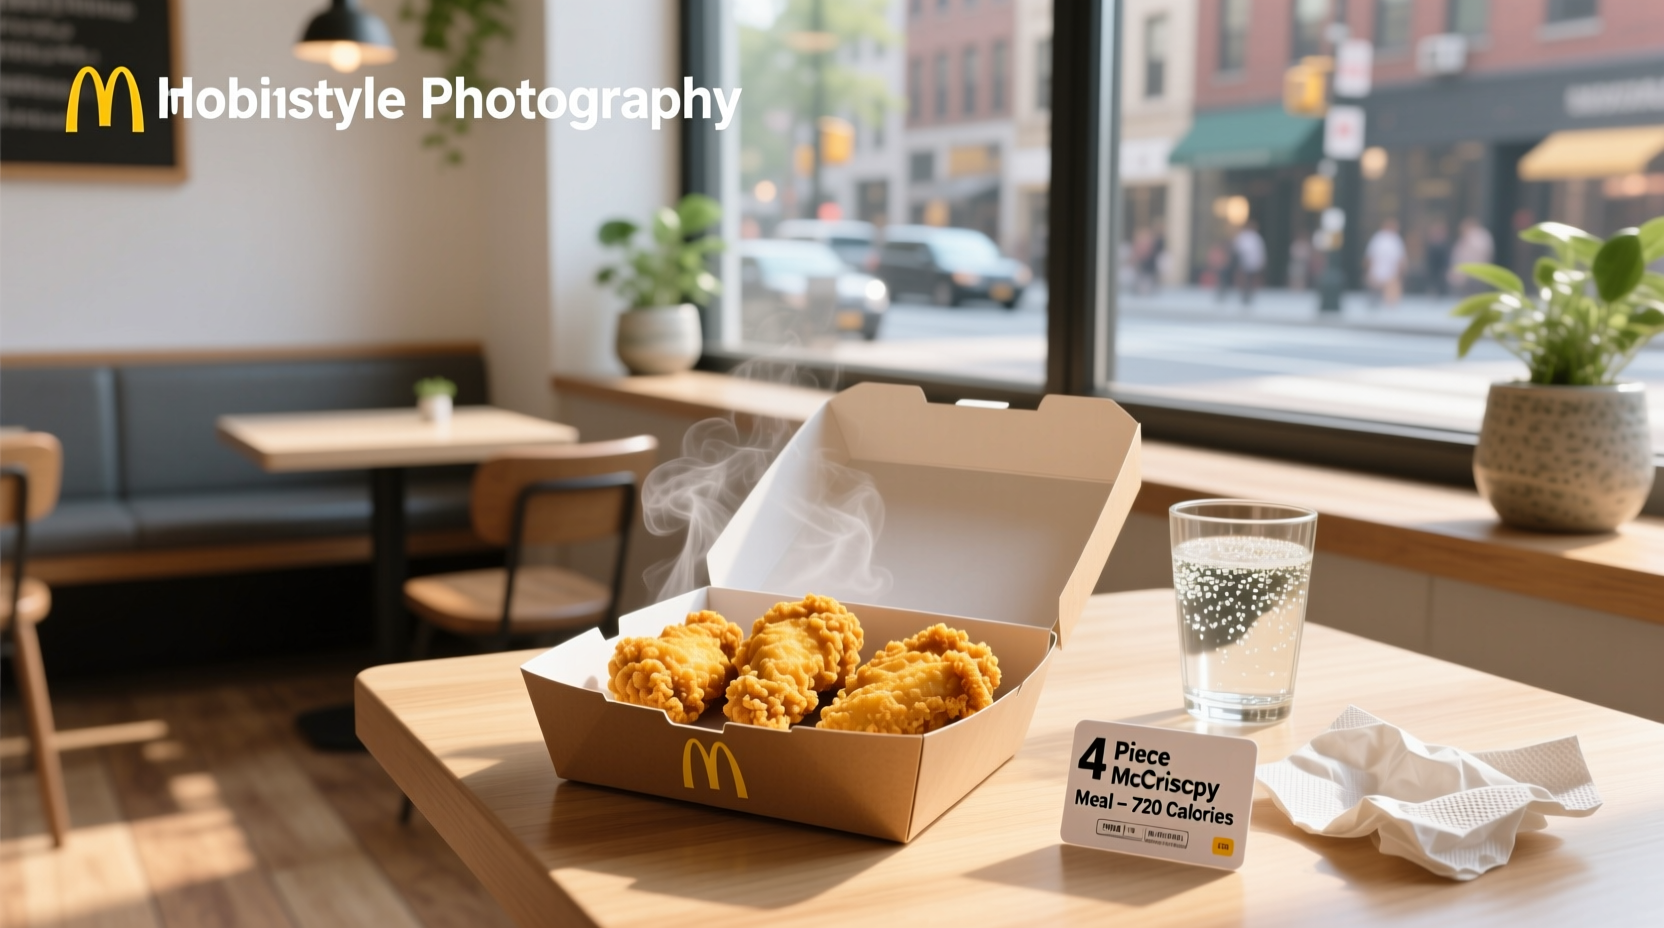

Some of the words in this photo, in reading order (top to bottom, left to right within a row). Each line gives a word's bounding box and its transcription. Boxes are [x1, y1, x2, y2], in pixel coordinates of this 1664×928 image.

[1077, 736, 1107, 781] 4
[1114, 740, 1171, 767] Piece
[1111, 765, 1221, 803] McCriscpy
[1074, 788, 1114, 810] Meal
[1131, 796, 1163, 816] 720
[1166, 801, 1234, 826] Calories
